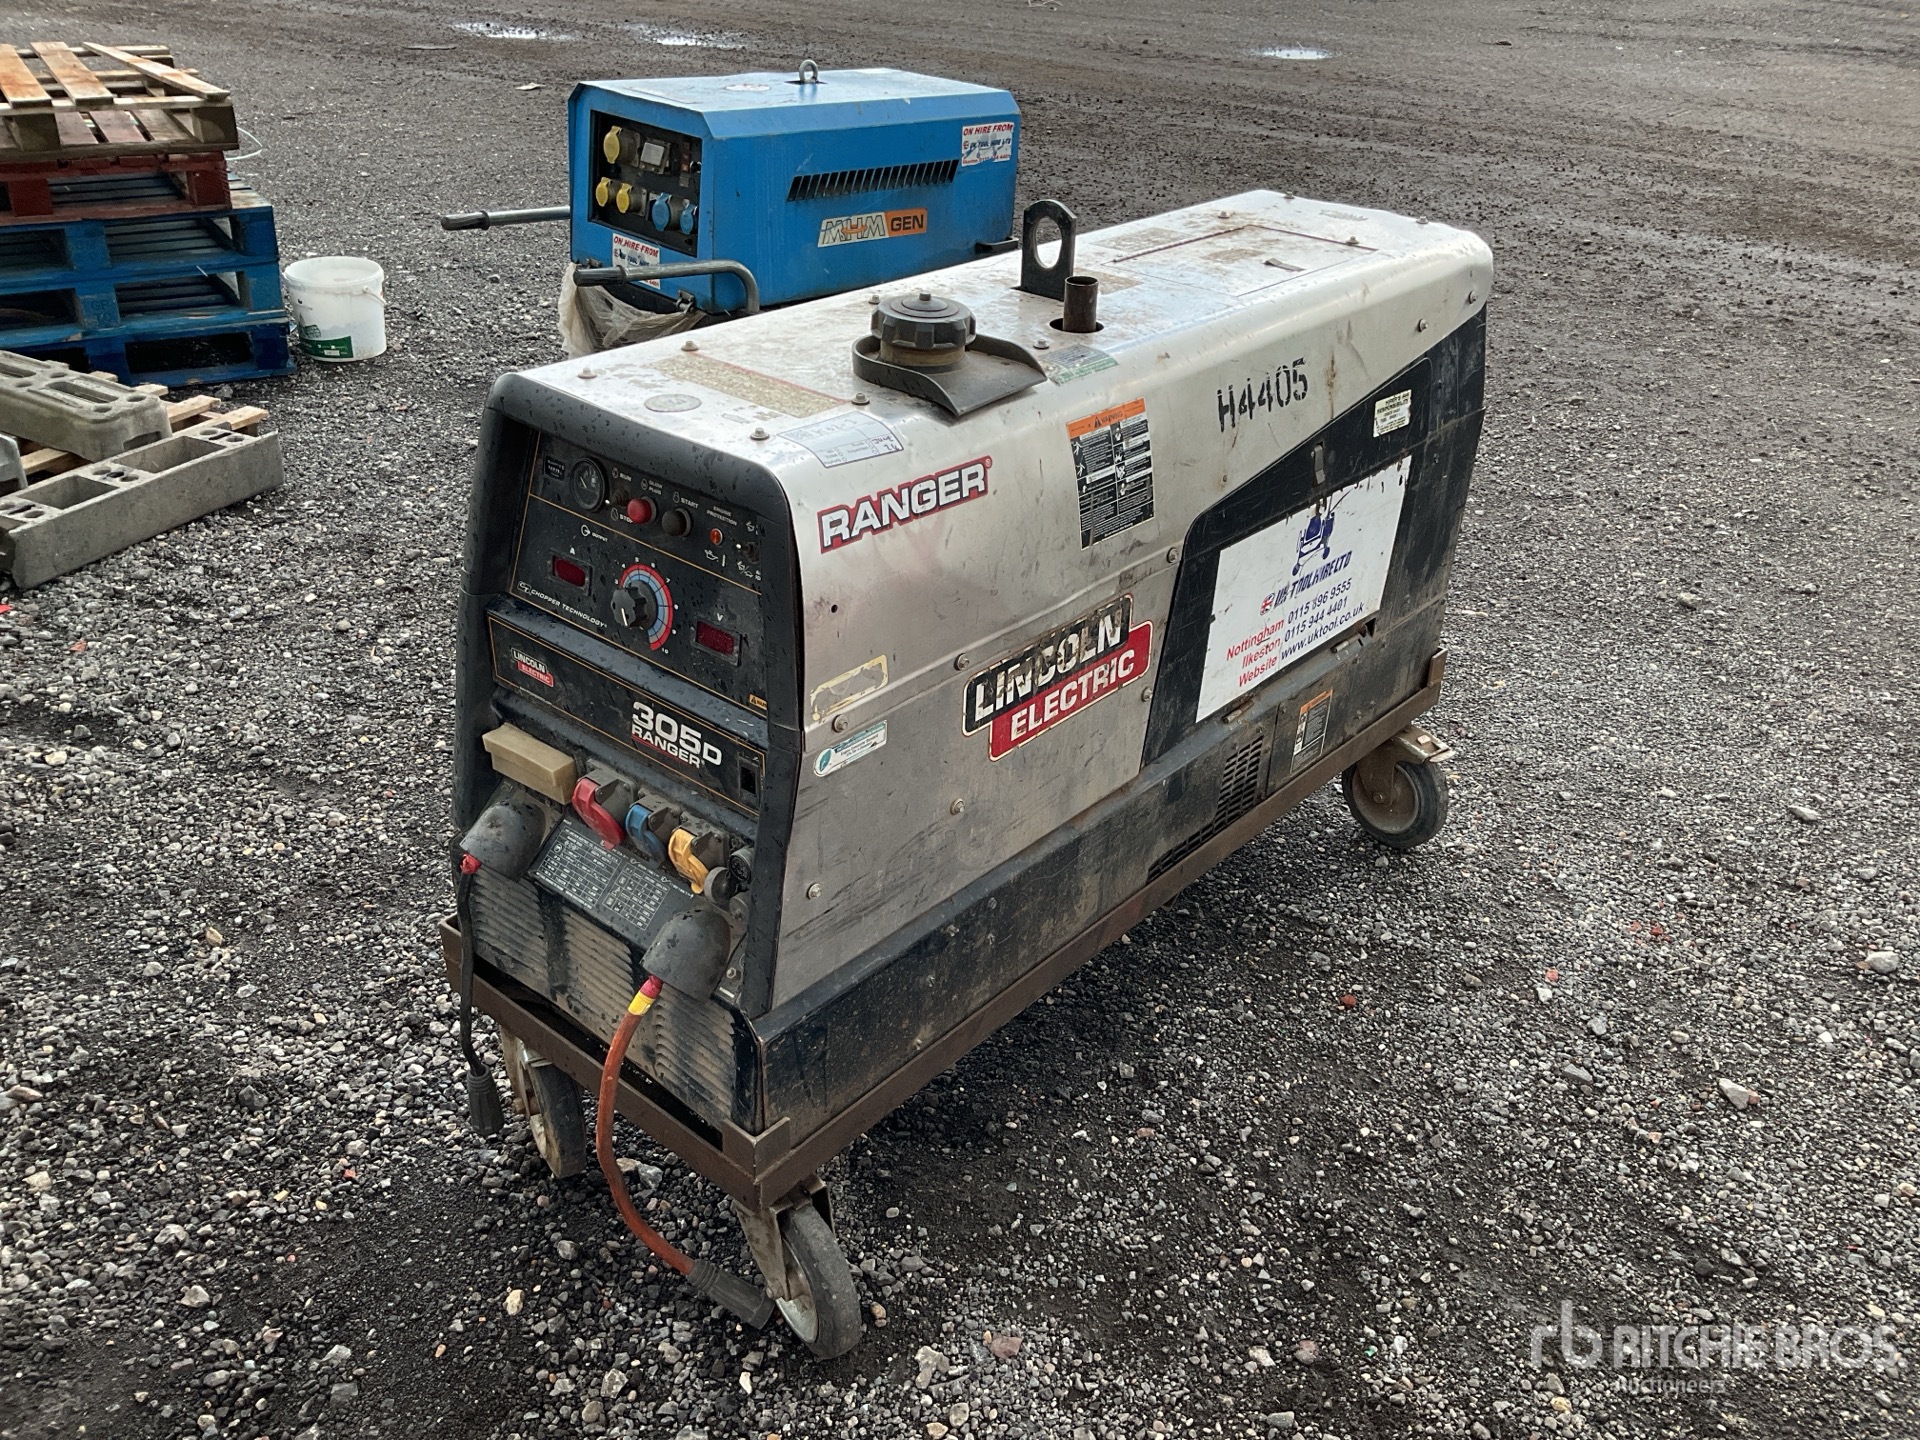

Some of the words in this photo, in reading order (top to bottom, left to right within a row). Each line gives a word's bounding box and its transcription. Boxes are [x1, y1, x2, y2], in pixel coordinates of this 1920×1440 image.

[963, 128, 974, 136] ON
[974, 125, 992, 135] HIRE
[992, 123, 1013, 132] FROM
[822, 214, 886, 245] MHM
[891, 214, 924, 232] GEN
[613, 236, 624, 245] ON
[622, 239, 640, 251] HIRE
[640, 245, 659, 257] FROM
[1217, 357, 1309, 433] H4405
[1100, 410, 1123, 423] WARNING
[680, 497, 699, 509] START
[821, 462, 986, 548] RANGER
[706, 510, 738, 526] PROTECTION
[569, 547, 576, 555] A
[531, 589, 561, 607] CHOPPER
[716, 613, 723, 622] V
[1226, 619, 1285, 661] Nottingham
[1287, 601, 1310, 625] 0115
[1329, 577, 1353, 600] 9555
[1238, 655, 1278, 688] Website
[1281, 601, 1364, 661] www.uktool.co.uk
[1241, 637, 1281, 669] Ilkeston
[1284, 619, 1307, 643] 0115
[1307, 609, 1325, 629] 944
[1326, 595, 1348, 617] 4401
[513, 650, 546, 673] LINCOLN
[521, 664, 551, 684] ELECTRIC
[974, 606, 1123, 722] LINCOLN
[1010, 648, 1136, 742] ELECTRIC
[631, 723, 701, 769] RANGER
[632, 701, 722, 766] 305D
